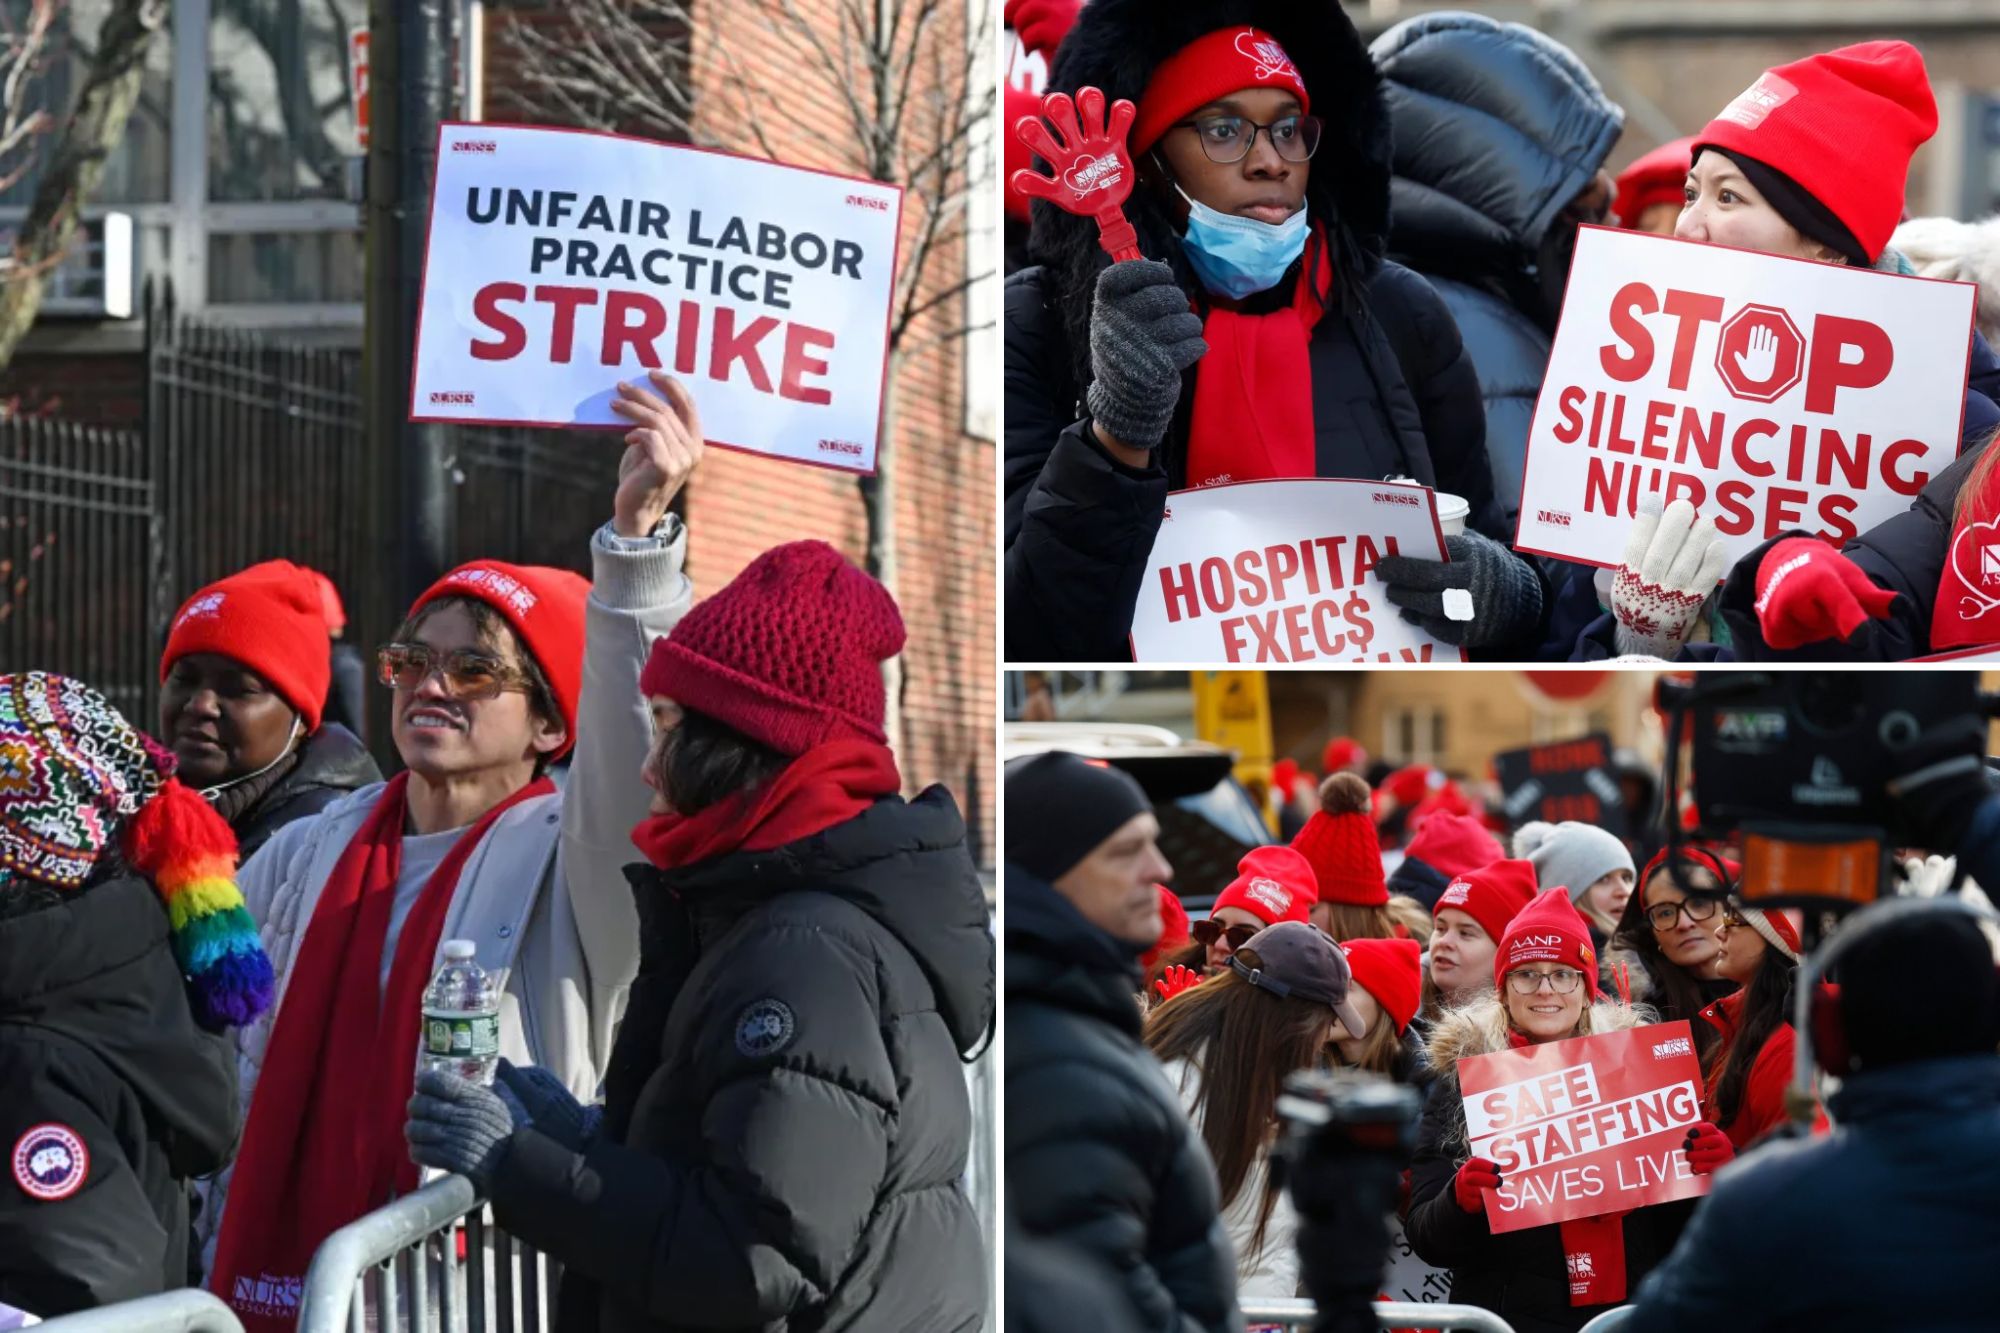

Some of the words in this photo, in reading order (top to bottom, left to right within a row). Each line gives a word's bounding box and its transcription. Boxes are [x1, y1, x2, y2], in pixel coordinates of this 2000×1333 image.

[1074, 153, 1118, 184] NURSES
[466, 186, 671, 239] UNFAIR
[687, 209, 865, 280] LABOR
[530, 237, 793, 309] PRACTICE
[470, 281, 835, 405] STRIKE
[1600, 281, 1894, 415] STOP
[1552, 385, 1930, 497] SILENCING
[1371, 492, 1419, 506] NURSES
[1537, 510, 1571, 526] NURSES
[1510, 935, 1562, 950] AANP
[1652, 1040, 1690, 1057] NURSES
[1482, 1068, 1595, 1130] SAFE
[1490, 1086, 1697, 1175] STAFFING
[1495, 1164, 1604, 1212] SAVES
[1616, 1148, 1695, 1191] LIVE
[233, 1275, 303, 1307] NURS
